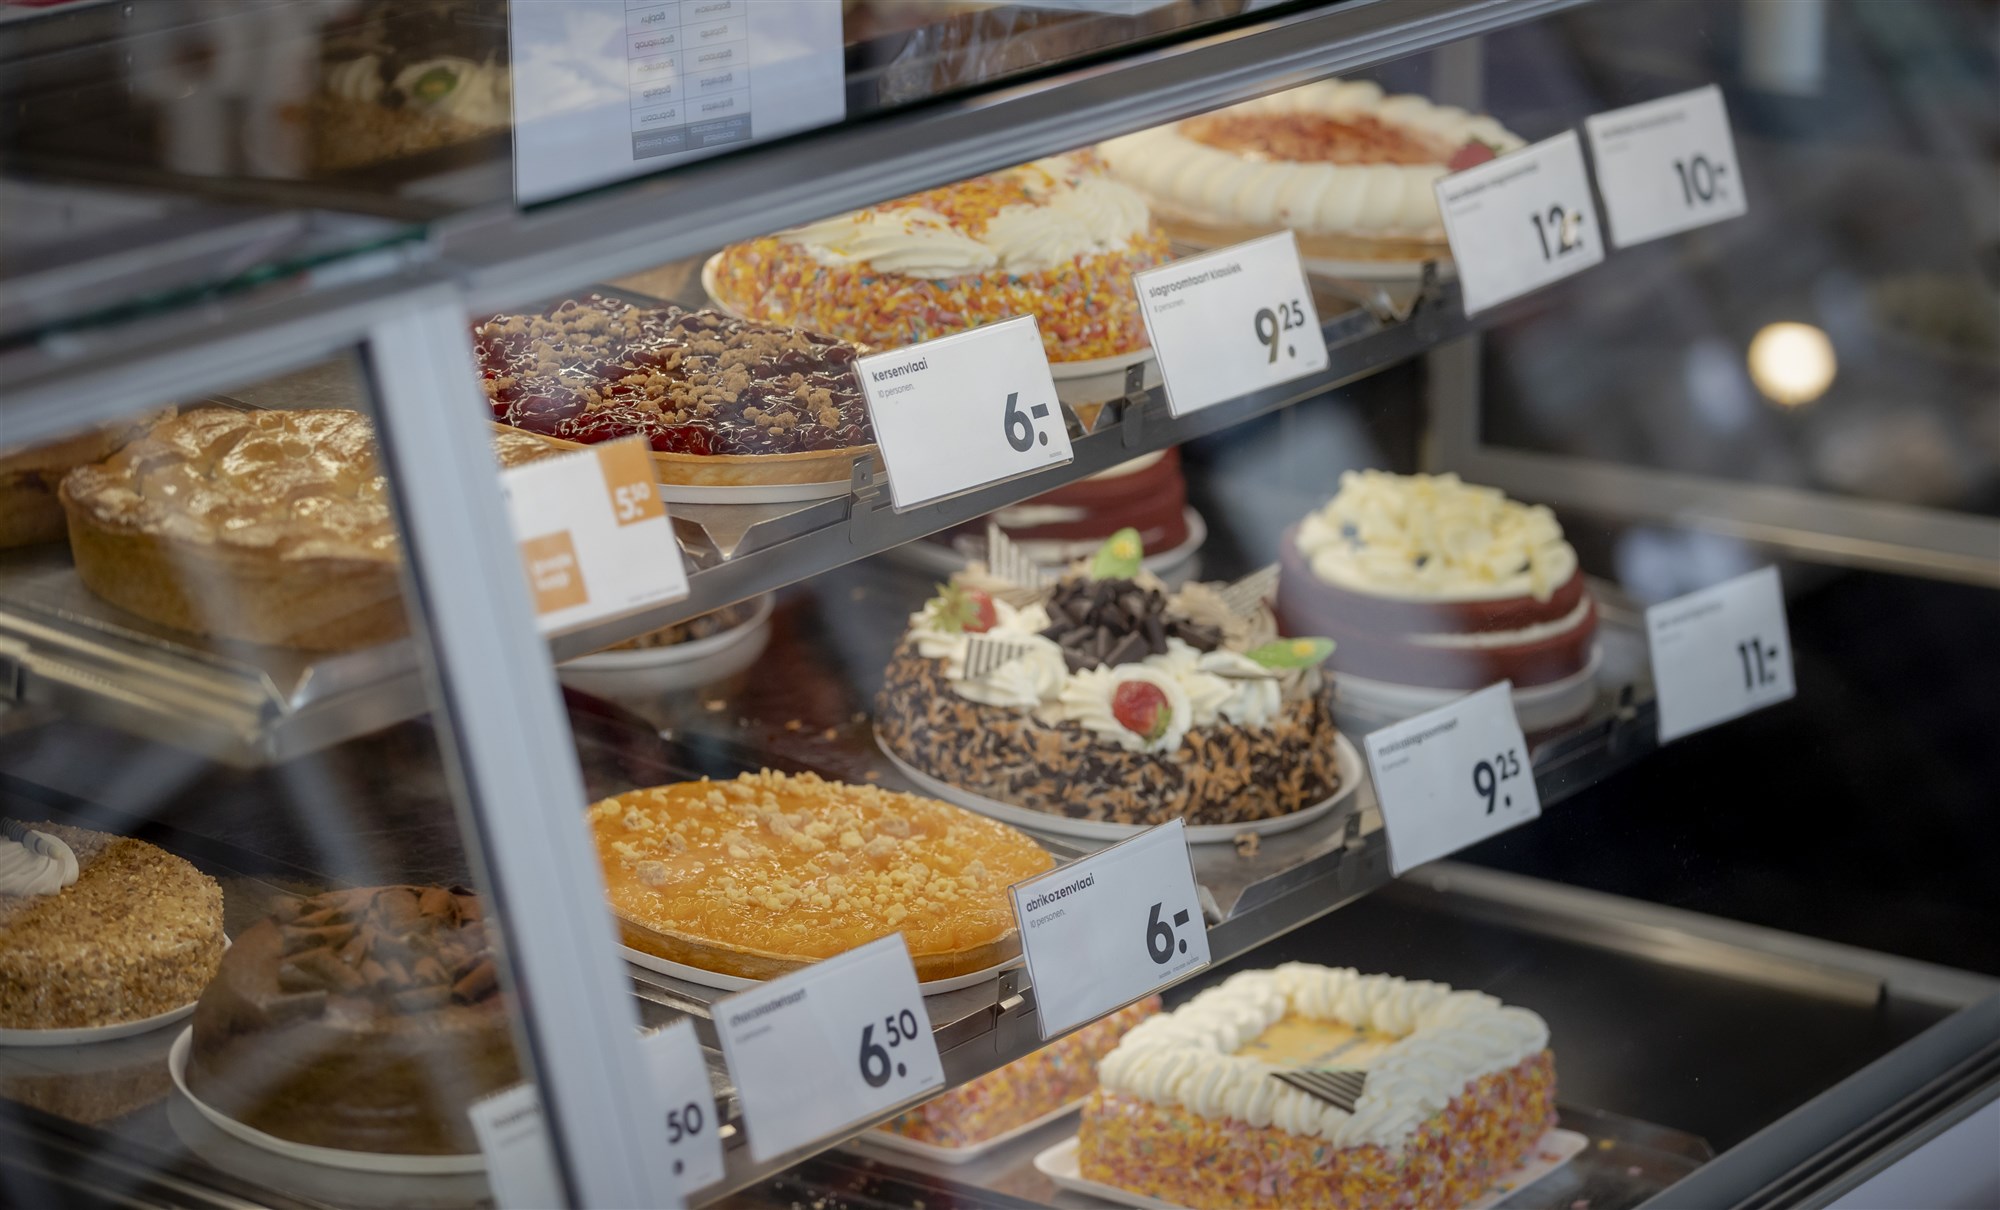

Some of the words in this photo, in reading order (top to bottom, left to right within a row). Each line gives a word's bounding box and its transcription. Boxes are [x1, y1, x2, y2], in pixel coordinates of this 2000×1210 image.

[1149, 272, 1209, 298] slagroomtaart
[872, 357, 929, 382] kersenvlaai
[1026, 872, 1095, 912] abrikozenvlaai
